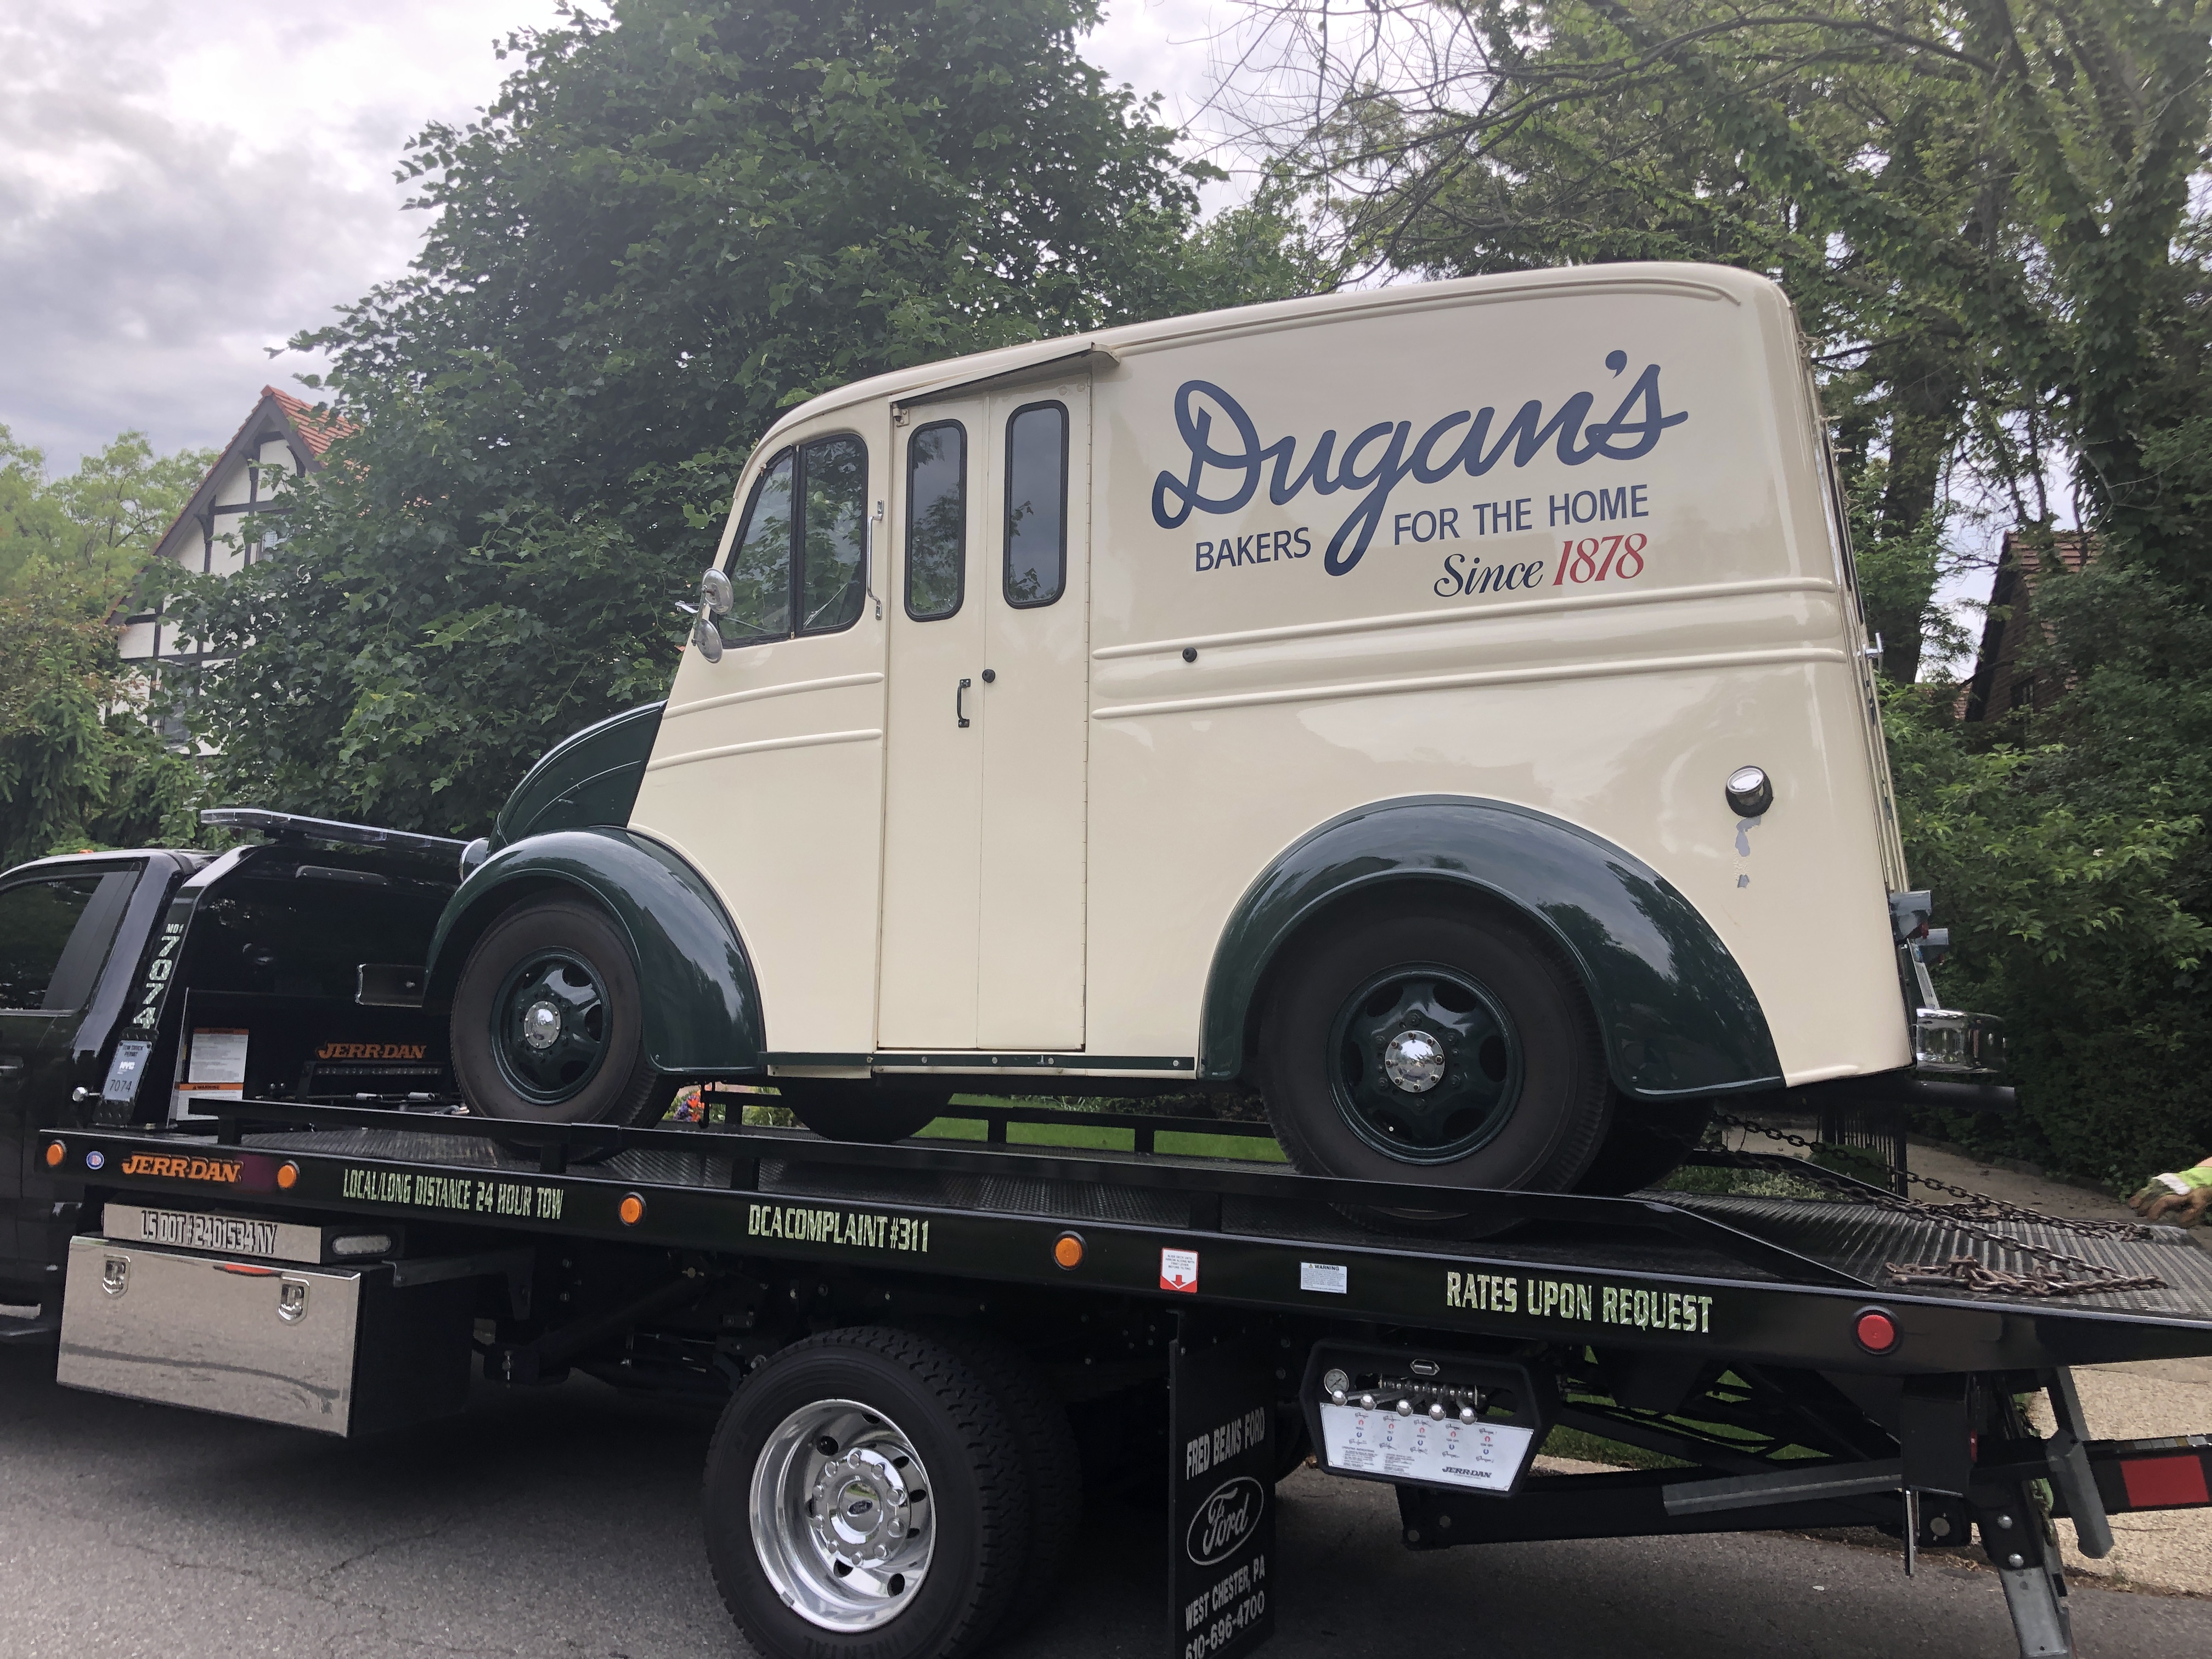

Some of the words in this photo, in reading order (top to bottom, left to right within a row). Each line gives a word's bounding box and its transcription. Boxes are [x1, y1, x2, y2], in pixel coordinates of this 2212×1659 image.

[1152, 349, 1688, 576] Dugan's
[1195, 527, 1311, 572] BAKERS
[1393, 507, 1459, 546] FOR
[1472, 498, 1532, 536] THE
[1549, 484, 1649, 527] HOME
[1434, 553, 1543, 597] Since
[1552, 533, 1647, 586] 1878
[133, 935, 180, 1029] 7074
[110, 1079, 132, 1092] 7074
[342, 1169, 411, 1204] LOCAL/LONG
[415, 1175, 471, 1210] DISTANCE
[476, 1181, 494, 1212] 24
[496, 1183, 532, 1217] HOUR
[537, 1187, 565, 1220] TOW
[160, 1212, 186, 1244] DOT
[257, 1222, 278, 1254] NY
[890, 1217, 929, 1252] #311
[1447, 1271, 1517, 1313] RATES
[1527, 1278, 1592, 1322] UPON
[1602, 1286, 1713, 1333] REQUEST
[1187, 1434, 1210, 1480] FRED
[1213, 1418, 1242, 1466] BEANS
[1244, 1407, 1265, 1449] FORD
[1203, 1487, 1250, 1556] Ford
[1186, 1592, 1209, 1632] WEST
[1212, 1565, 1251, 1611] CHESTER,
[1253, 1554, 1265, 1583] PA
[1186, 1590, 1265, 1659] 610-696-4700
